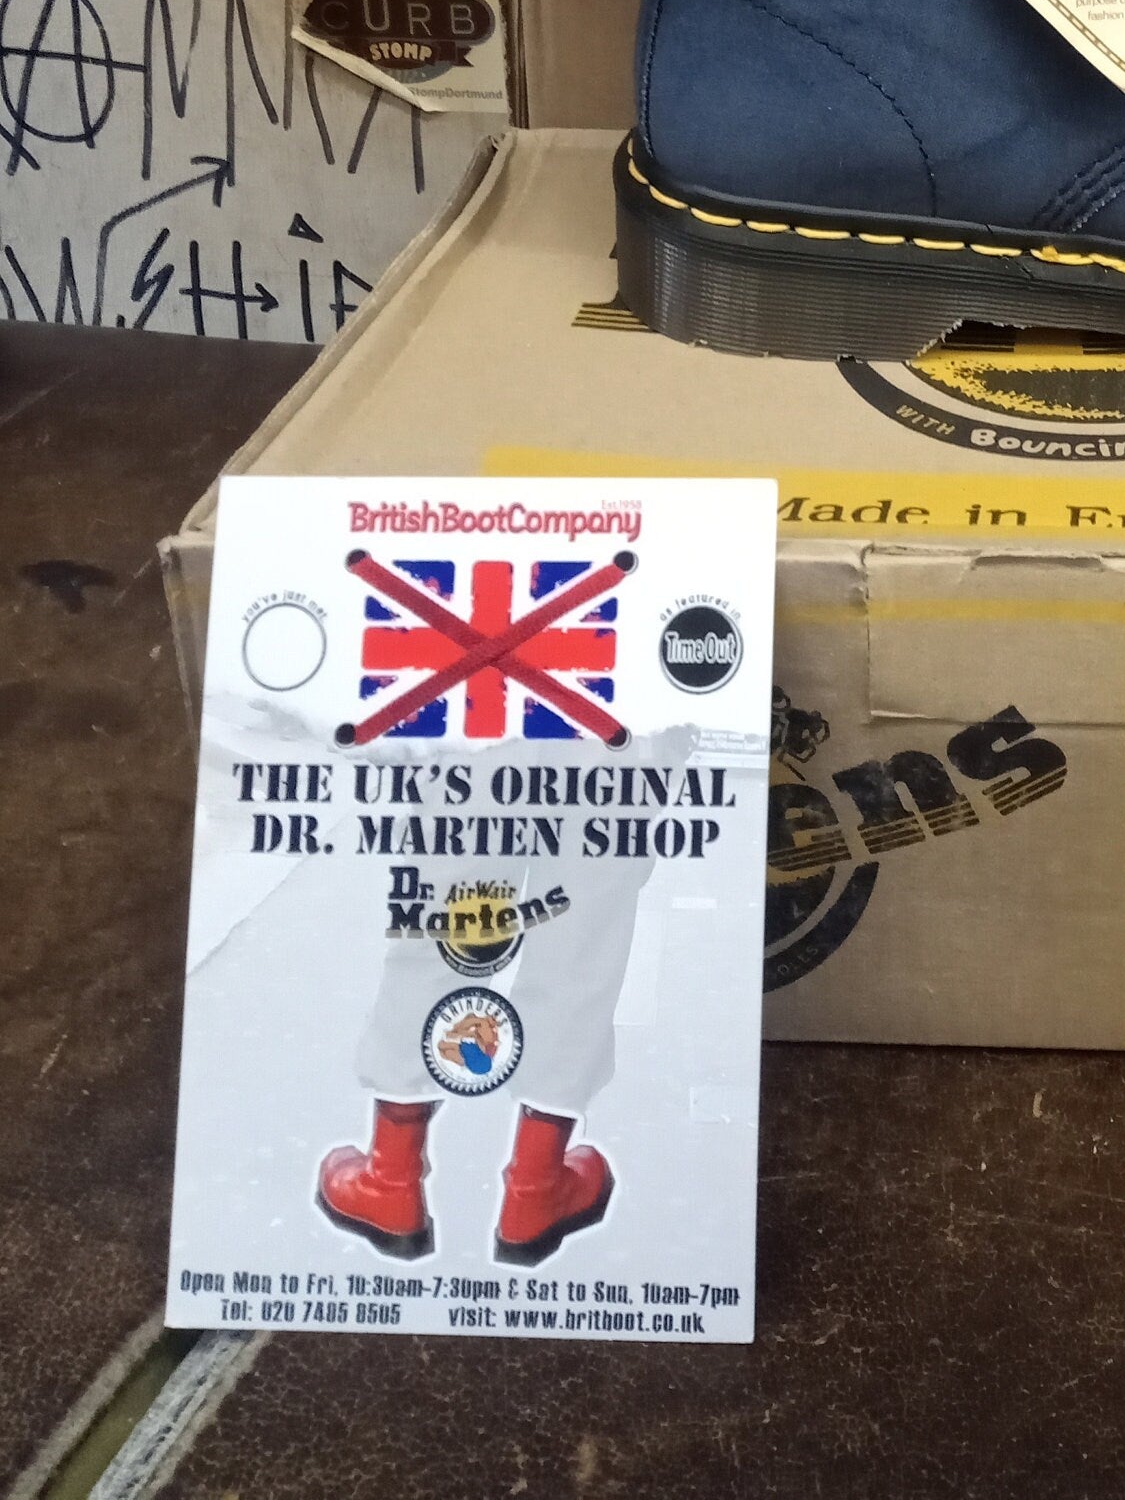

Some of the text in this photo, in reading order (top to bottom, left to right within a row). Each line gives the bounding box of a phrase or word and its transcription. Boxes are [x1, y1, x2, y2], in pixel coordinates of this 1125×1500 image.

[369, 42, 432, 61] STOMP
[895, 403, 955, 437] WITH
[347, 501, 643, 542] BritishBootCompany
[966, 499, 1027, 526] in
[234, 764, 734, 805] THE UK'S ORIGINAL
[253, 815, 719, 856] DR. MARTEN SHOP
[445, 880, 516, 905] AirWair
[385, 885, 571, 939] Martens
[180, 1271, 224, 1293] Open
[233, 1272, 271, 1293] Mon
[281, 1274, 298, 1293] to
[526, 1279, 557, 1300] Sat
[568, 1282, 585, 1301] to
